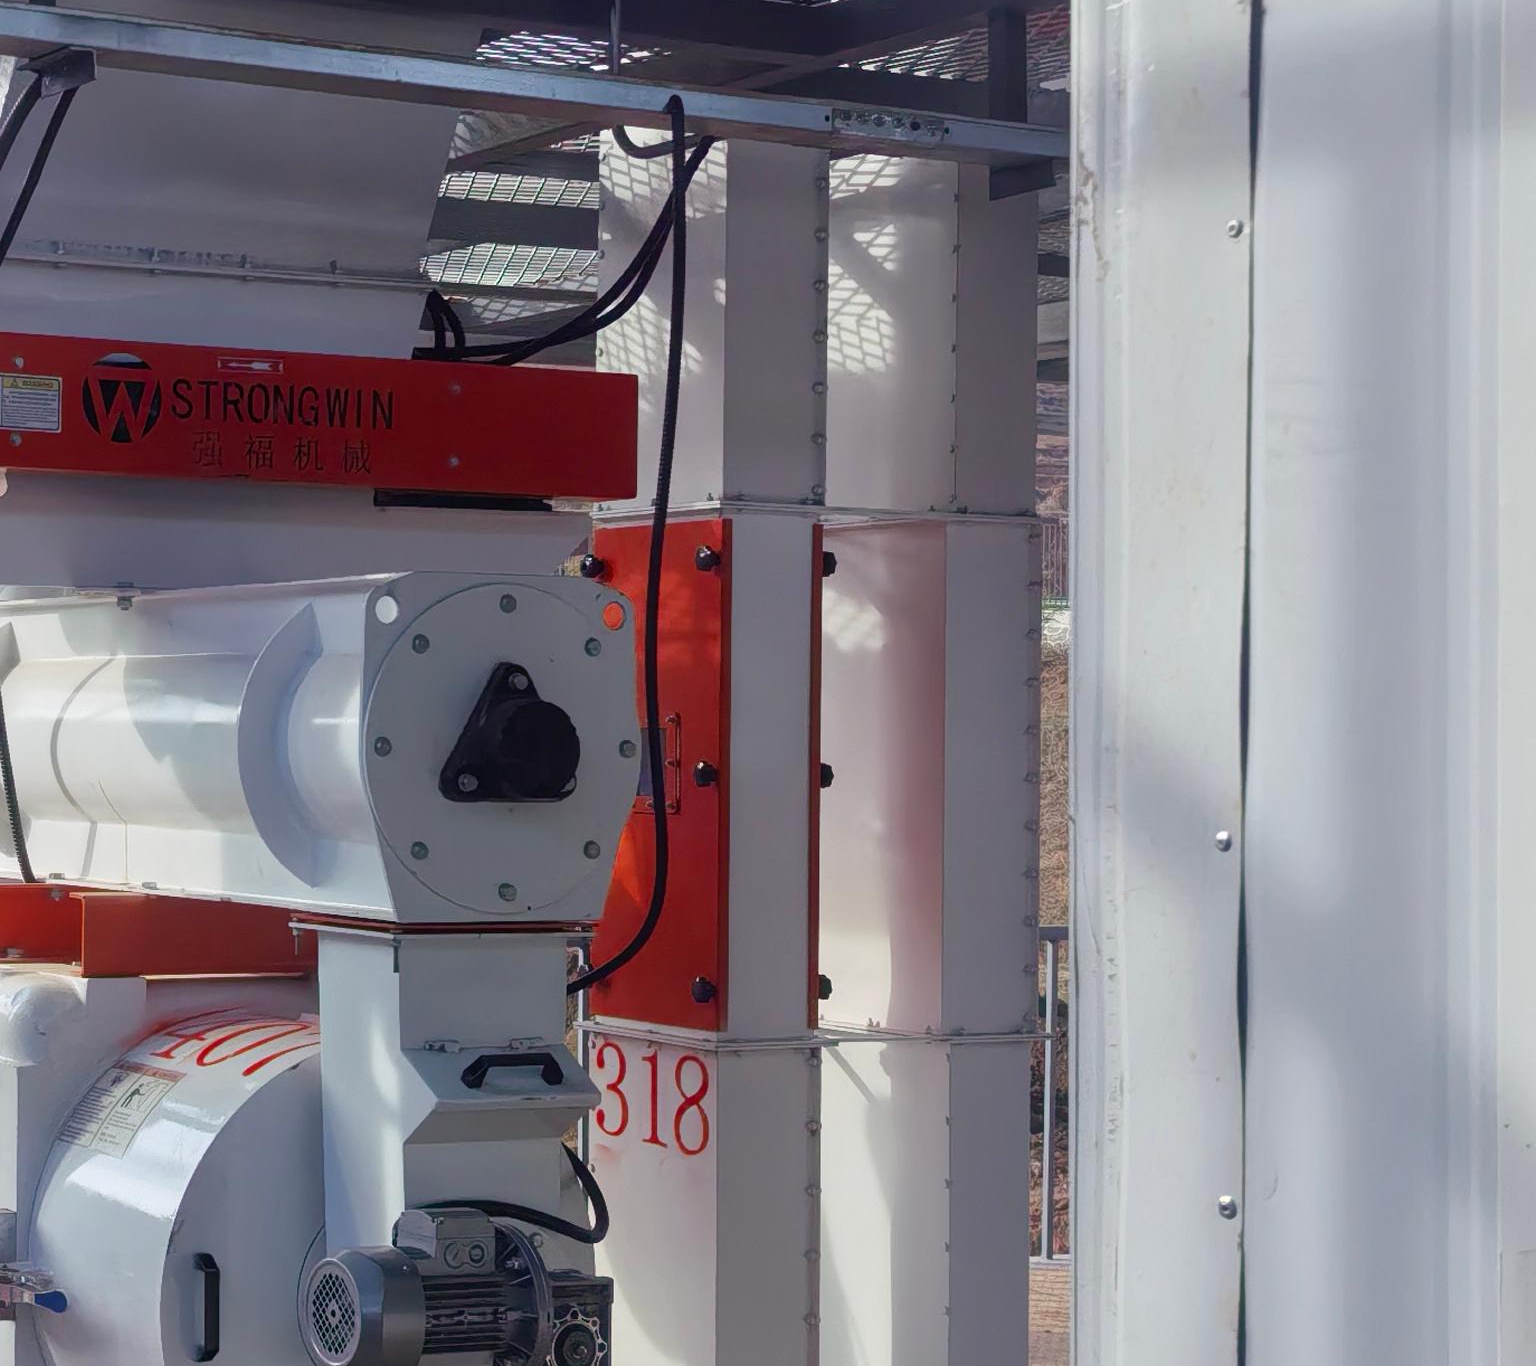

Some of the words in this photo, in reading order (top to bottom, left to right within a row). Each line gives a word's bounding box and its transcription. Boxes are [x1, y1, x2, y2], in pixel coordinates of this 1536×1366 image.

[171, 378, 394, 429] STRONGWIN
[192, 431, 372, 474] 强福机械
[595, 1041, 709, 1155] 318
